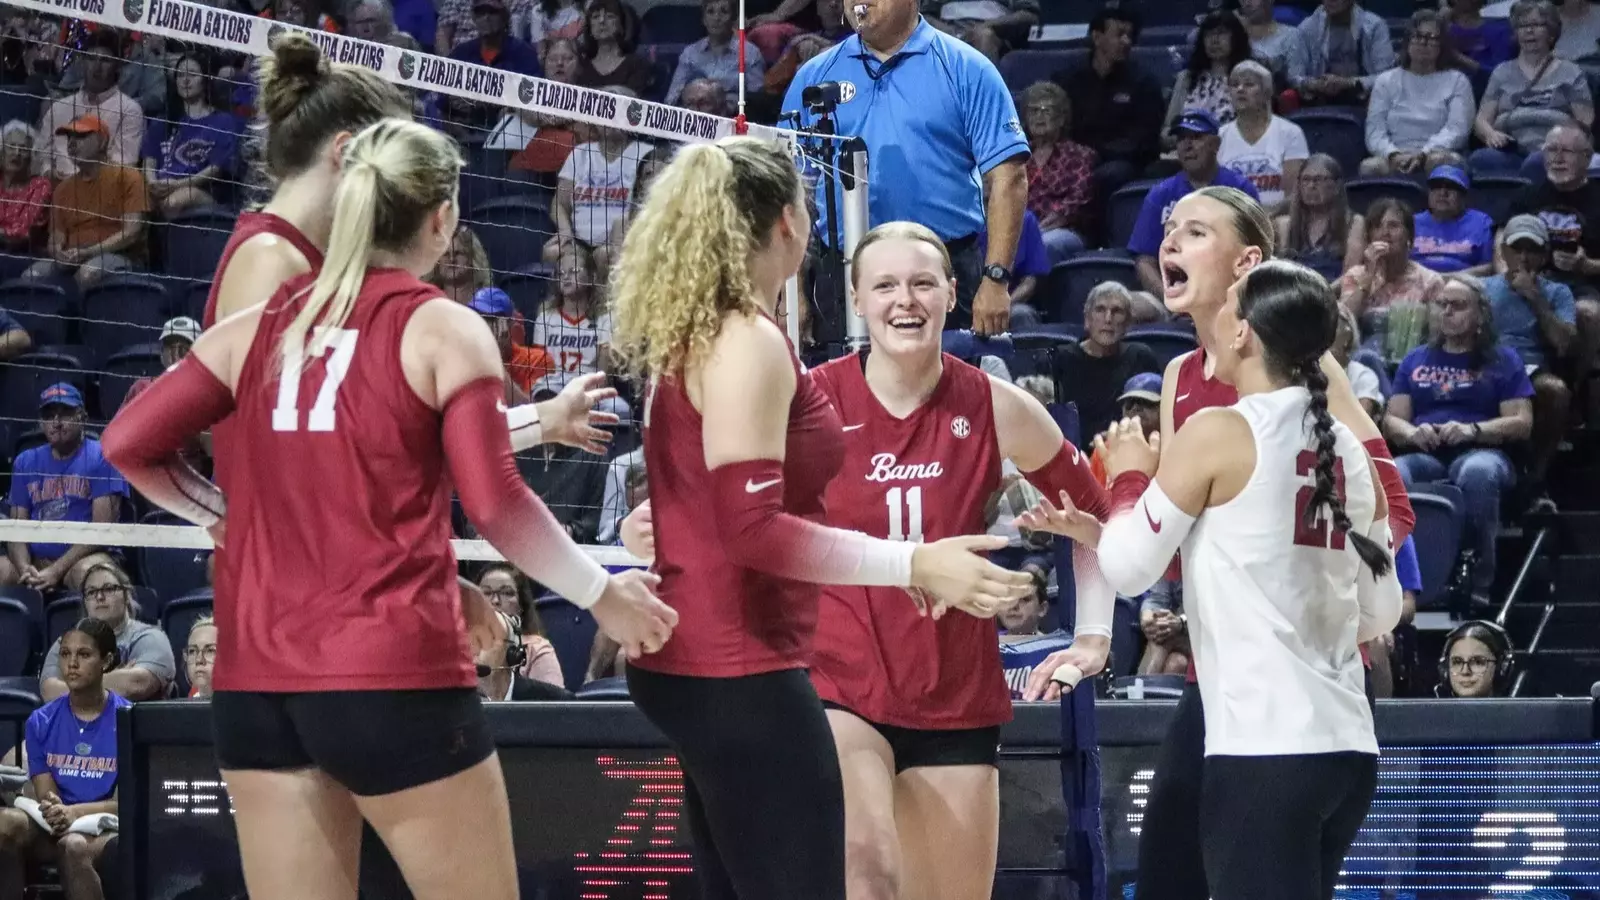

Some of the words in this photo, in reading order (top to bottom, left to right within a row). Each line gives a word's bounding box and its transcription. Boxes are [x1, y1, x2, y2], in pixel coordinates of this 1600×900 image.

[147, 0, 203, 35] FLORIDA
[203, 10, 252, 45] GATORS
[340, 40, 385, 71] GATORS
[417, 56, 464, 90] FLORIDA
[464, 67, 505, 98] GATORS
[535, 82, 579, 113] FLORIDA
[579, 90, 617, 121] GATORS
[644, 104, 683, 134] FLORIDA
[683, 113, 719, 140] GATORS
[271, 325, 360, 432] 17
[559, 351, 583, 372] 17
[951, 416, 971, 438] SEC
[864, 452, 944, 483] Bama
[886, 486, 925, 544] 11
[1293, 449, 1347, 551] 21
[58, 769, 80, 777] GAME
[80, 771, 104, 779] CREW
